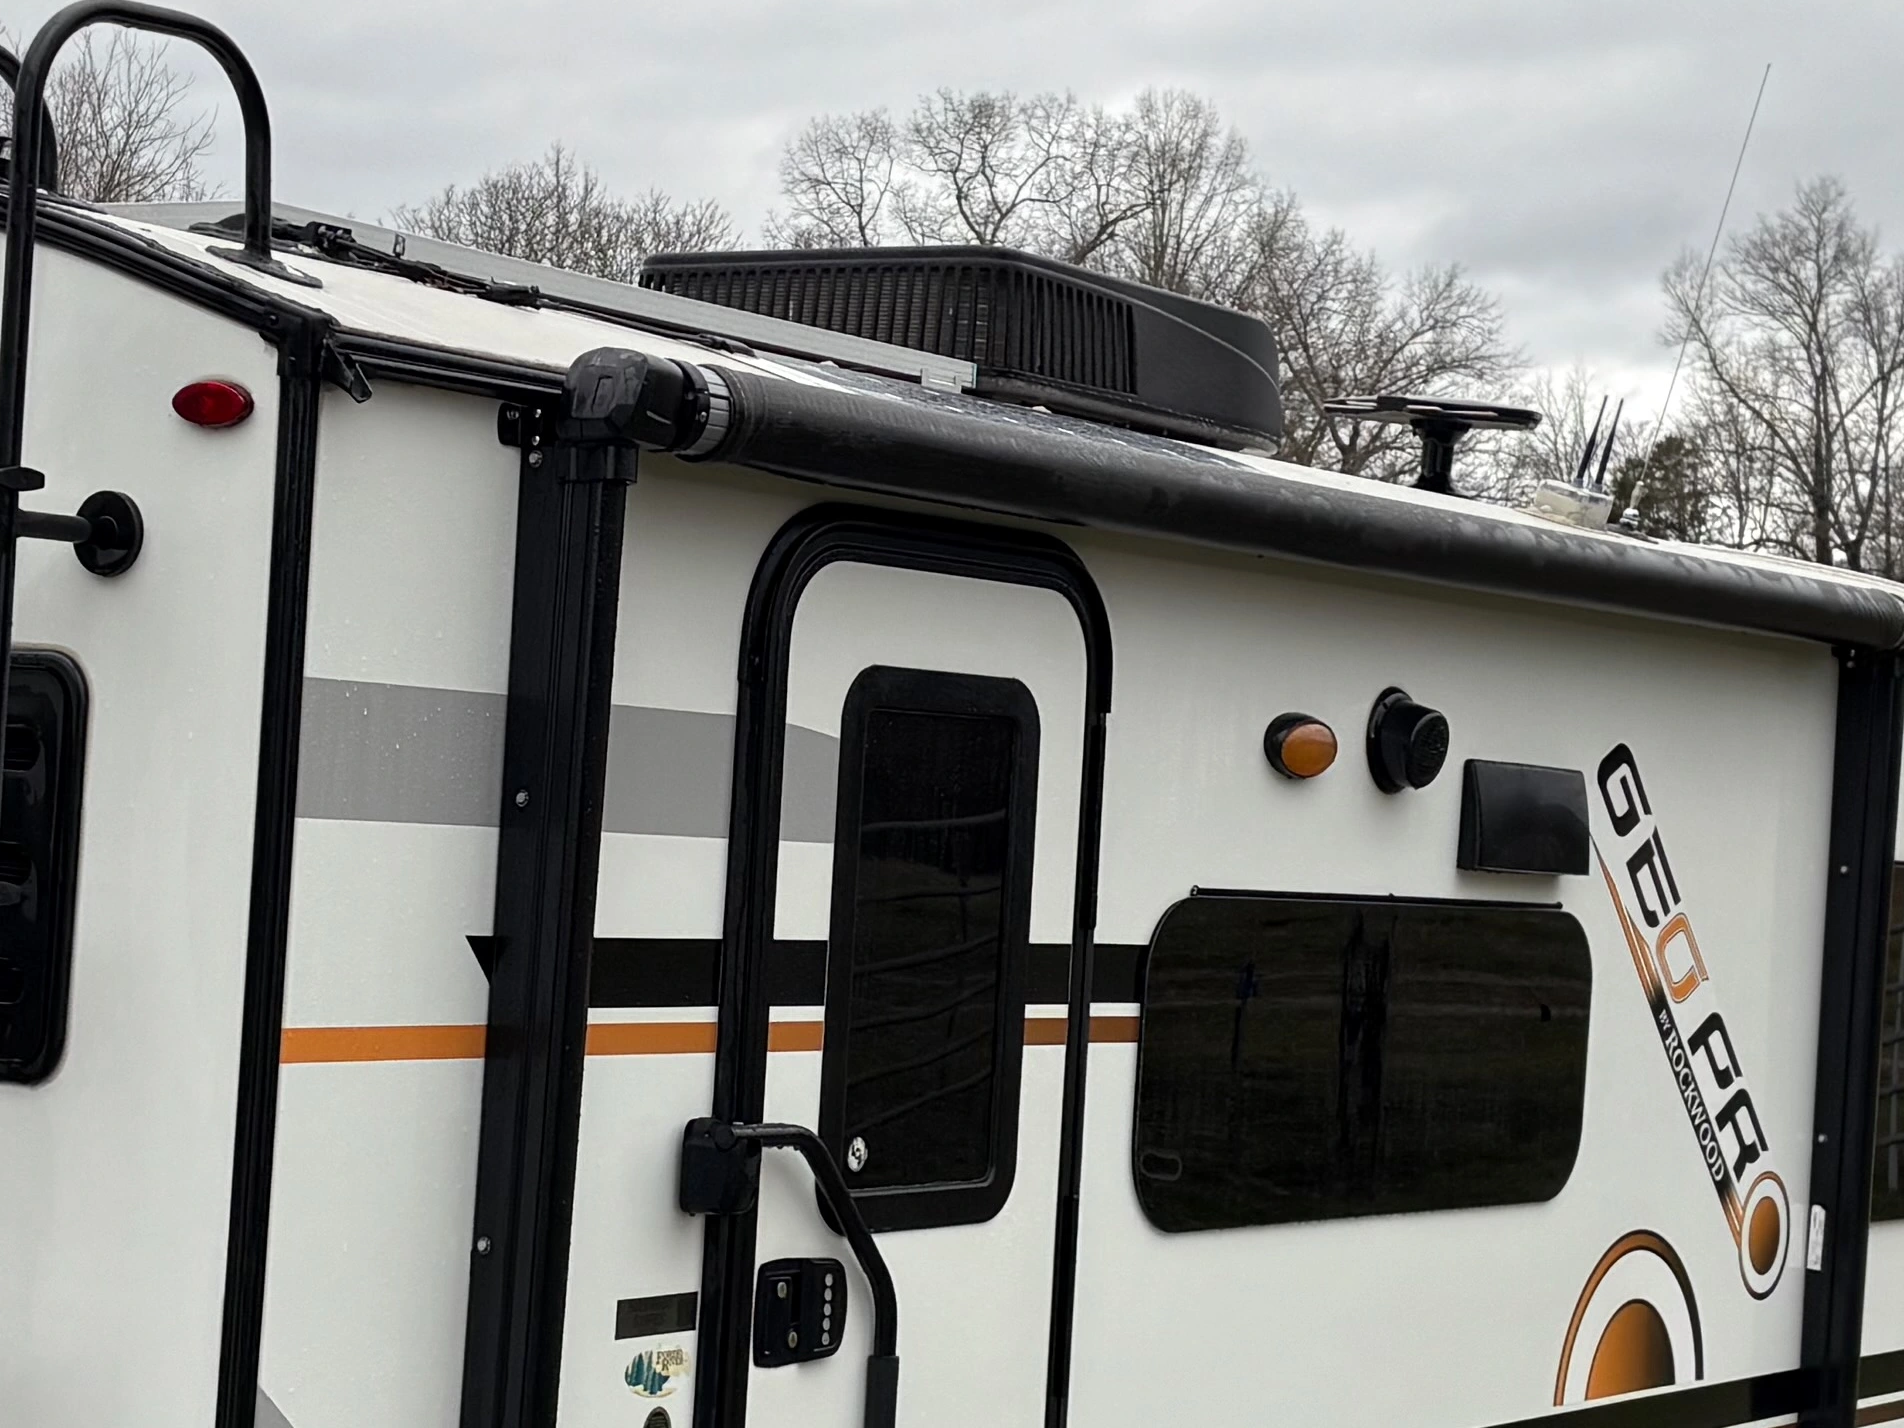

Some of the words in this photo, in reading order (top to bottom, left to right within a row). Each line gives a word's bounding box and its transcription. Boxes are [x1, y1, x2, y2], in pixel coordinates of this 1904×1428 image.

[1596, 742, 1710, 1004] GEO
[1658, 1009, 1672, 1031] BY
[1664, 1029, 1727, 1183] ROCKWOOD
